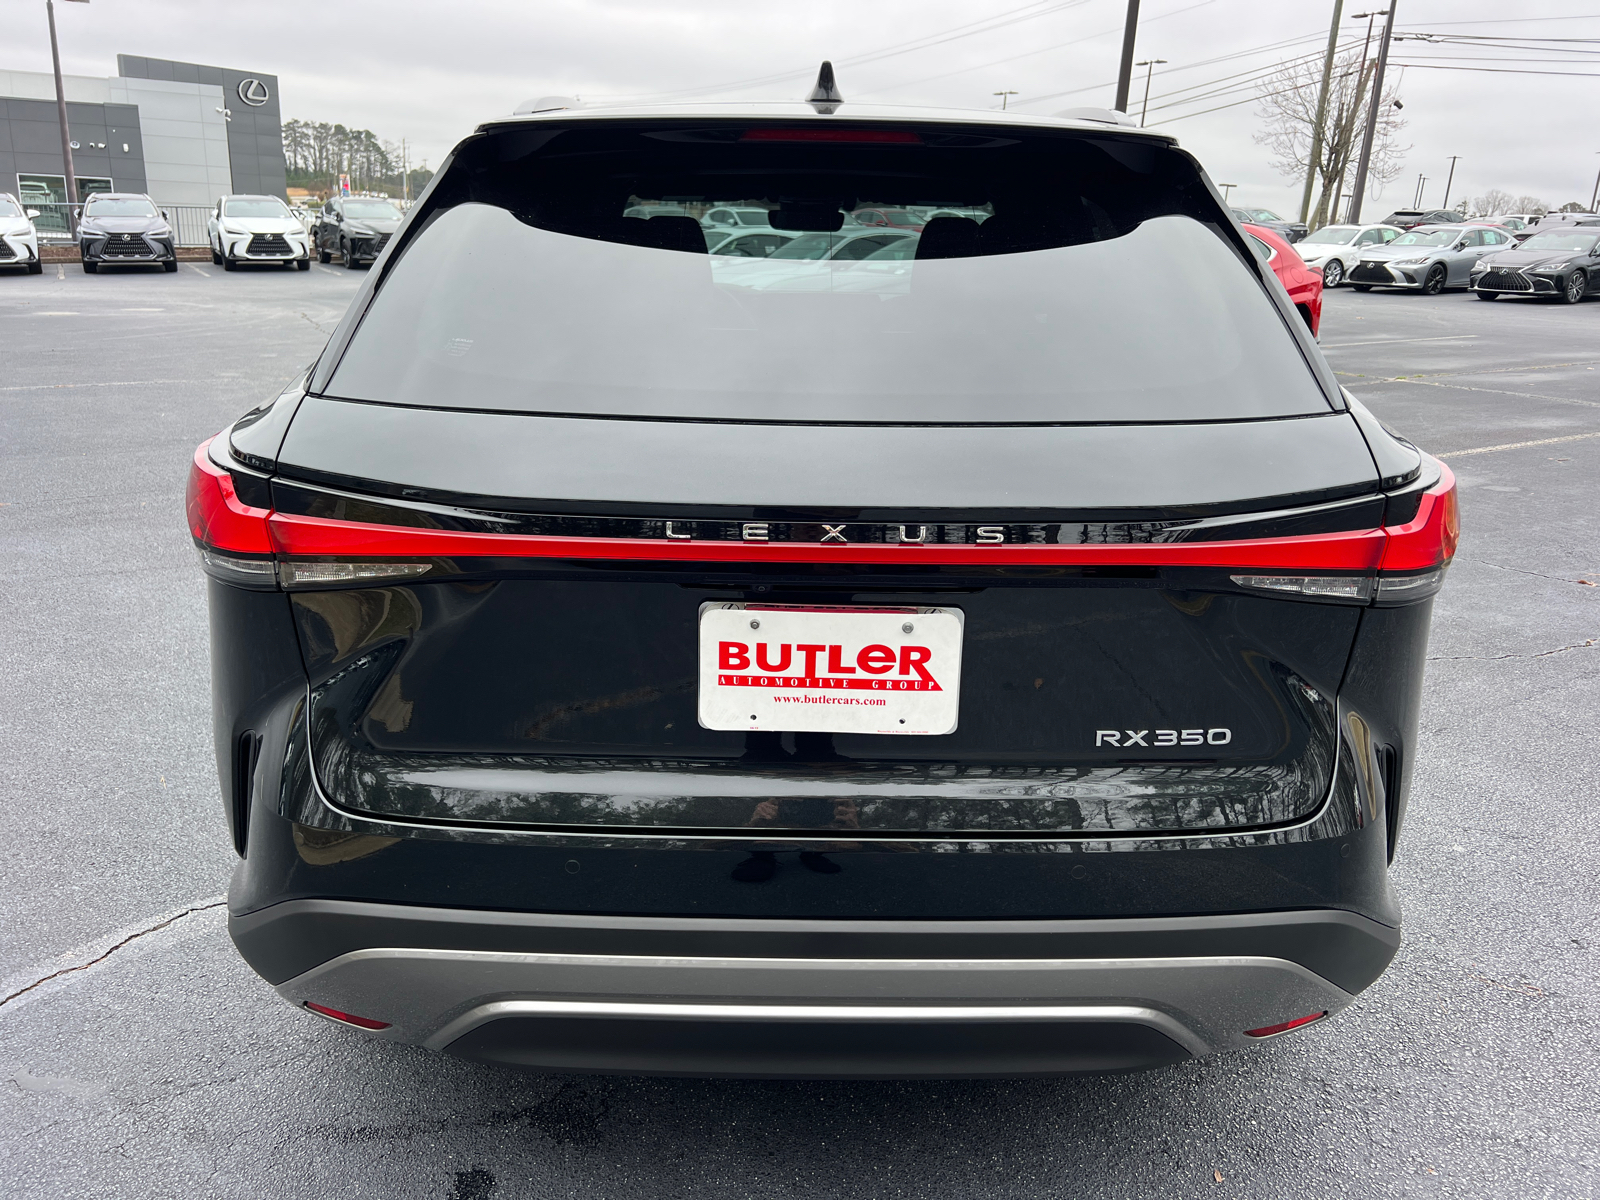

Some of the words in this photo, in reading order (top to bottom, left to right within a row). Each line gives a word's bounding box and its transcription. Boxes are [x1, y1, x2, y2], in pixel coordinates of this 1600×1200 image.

[666, 521, 1004, 543] LEXUS
[719, 676, 850, 689] AUTOMOTIVE
[872, 679, 935, 691] GROUP
[773, 694, 887, 706] www.butlercars.com
